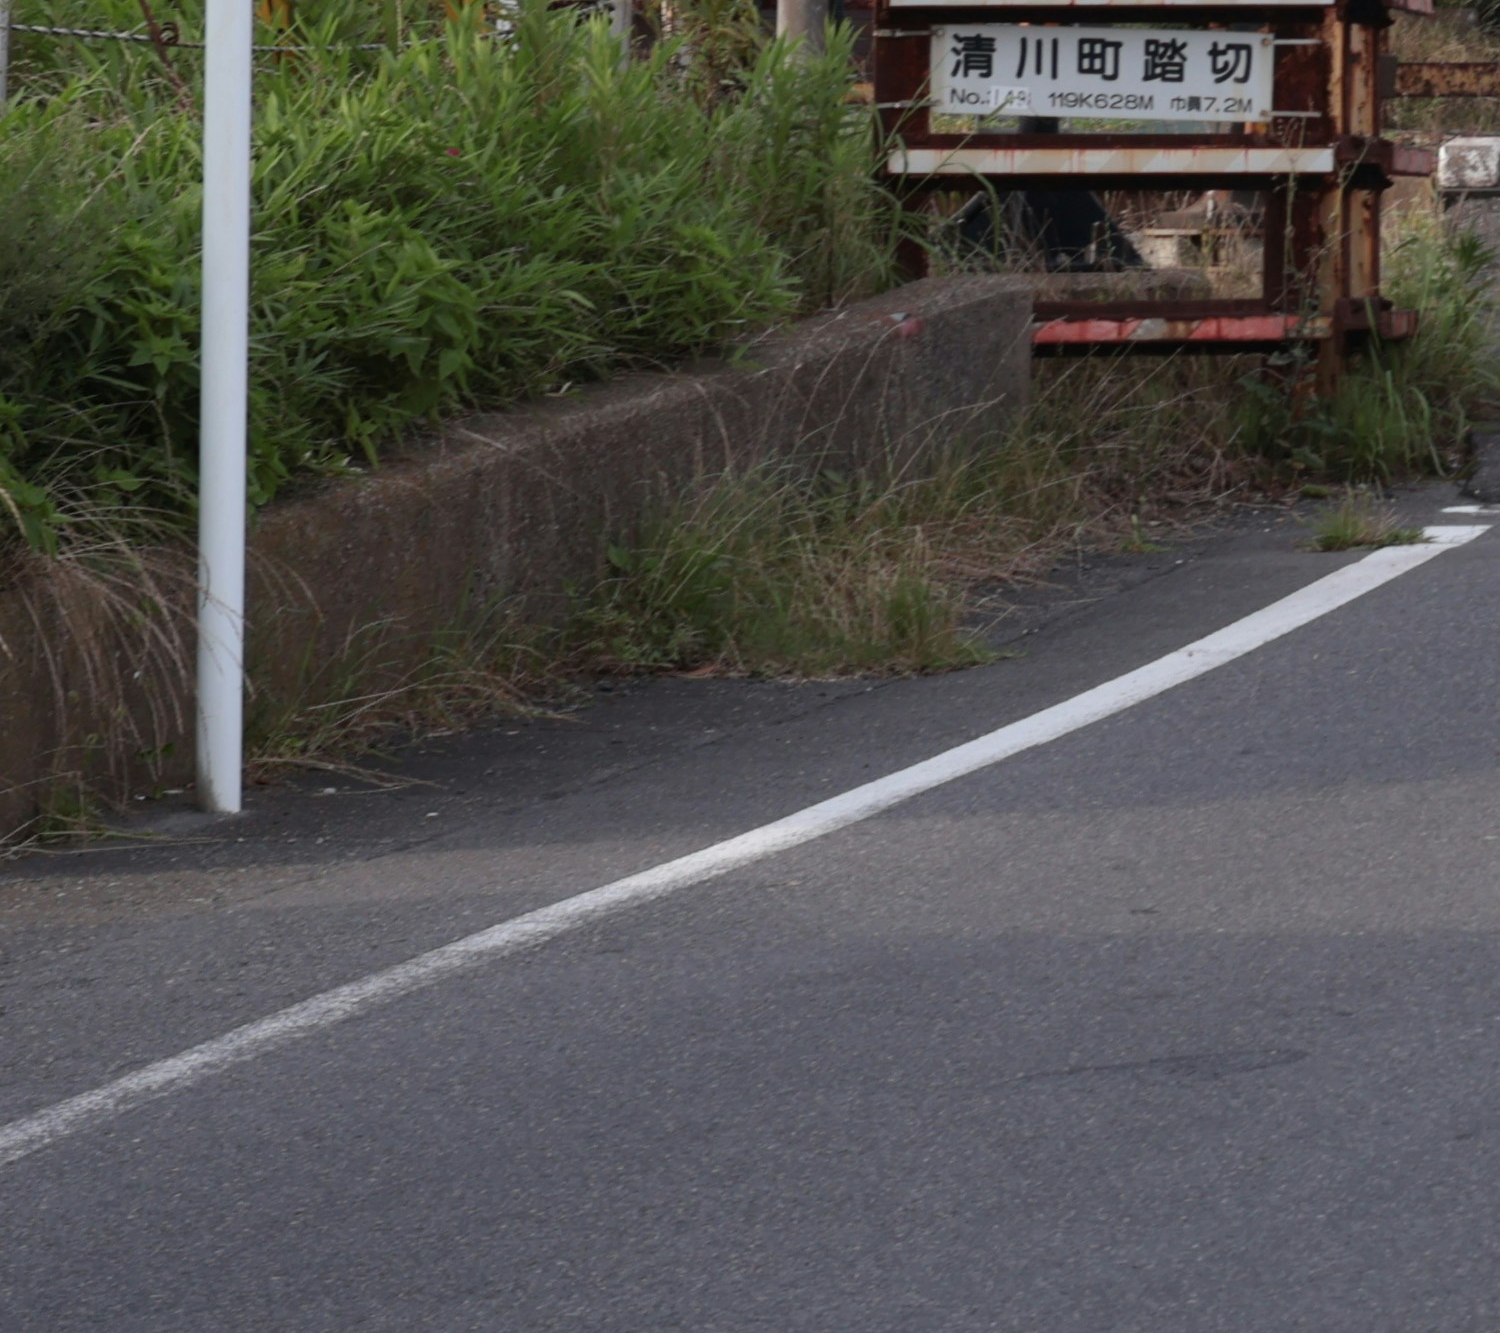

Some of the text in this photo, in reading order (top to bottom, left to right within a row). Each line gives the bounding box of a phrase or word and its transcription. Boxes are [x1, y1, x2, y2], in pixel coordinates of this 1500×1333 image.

[950, 33, 1253, 84] 清川町踏切
[1047, 91, 1154, 111] 119K628M
